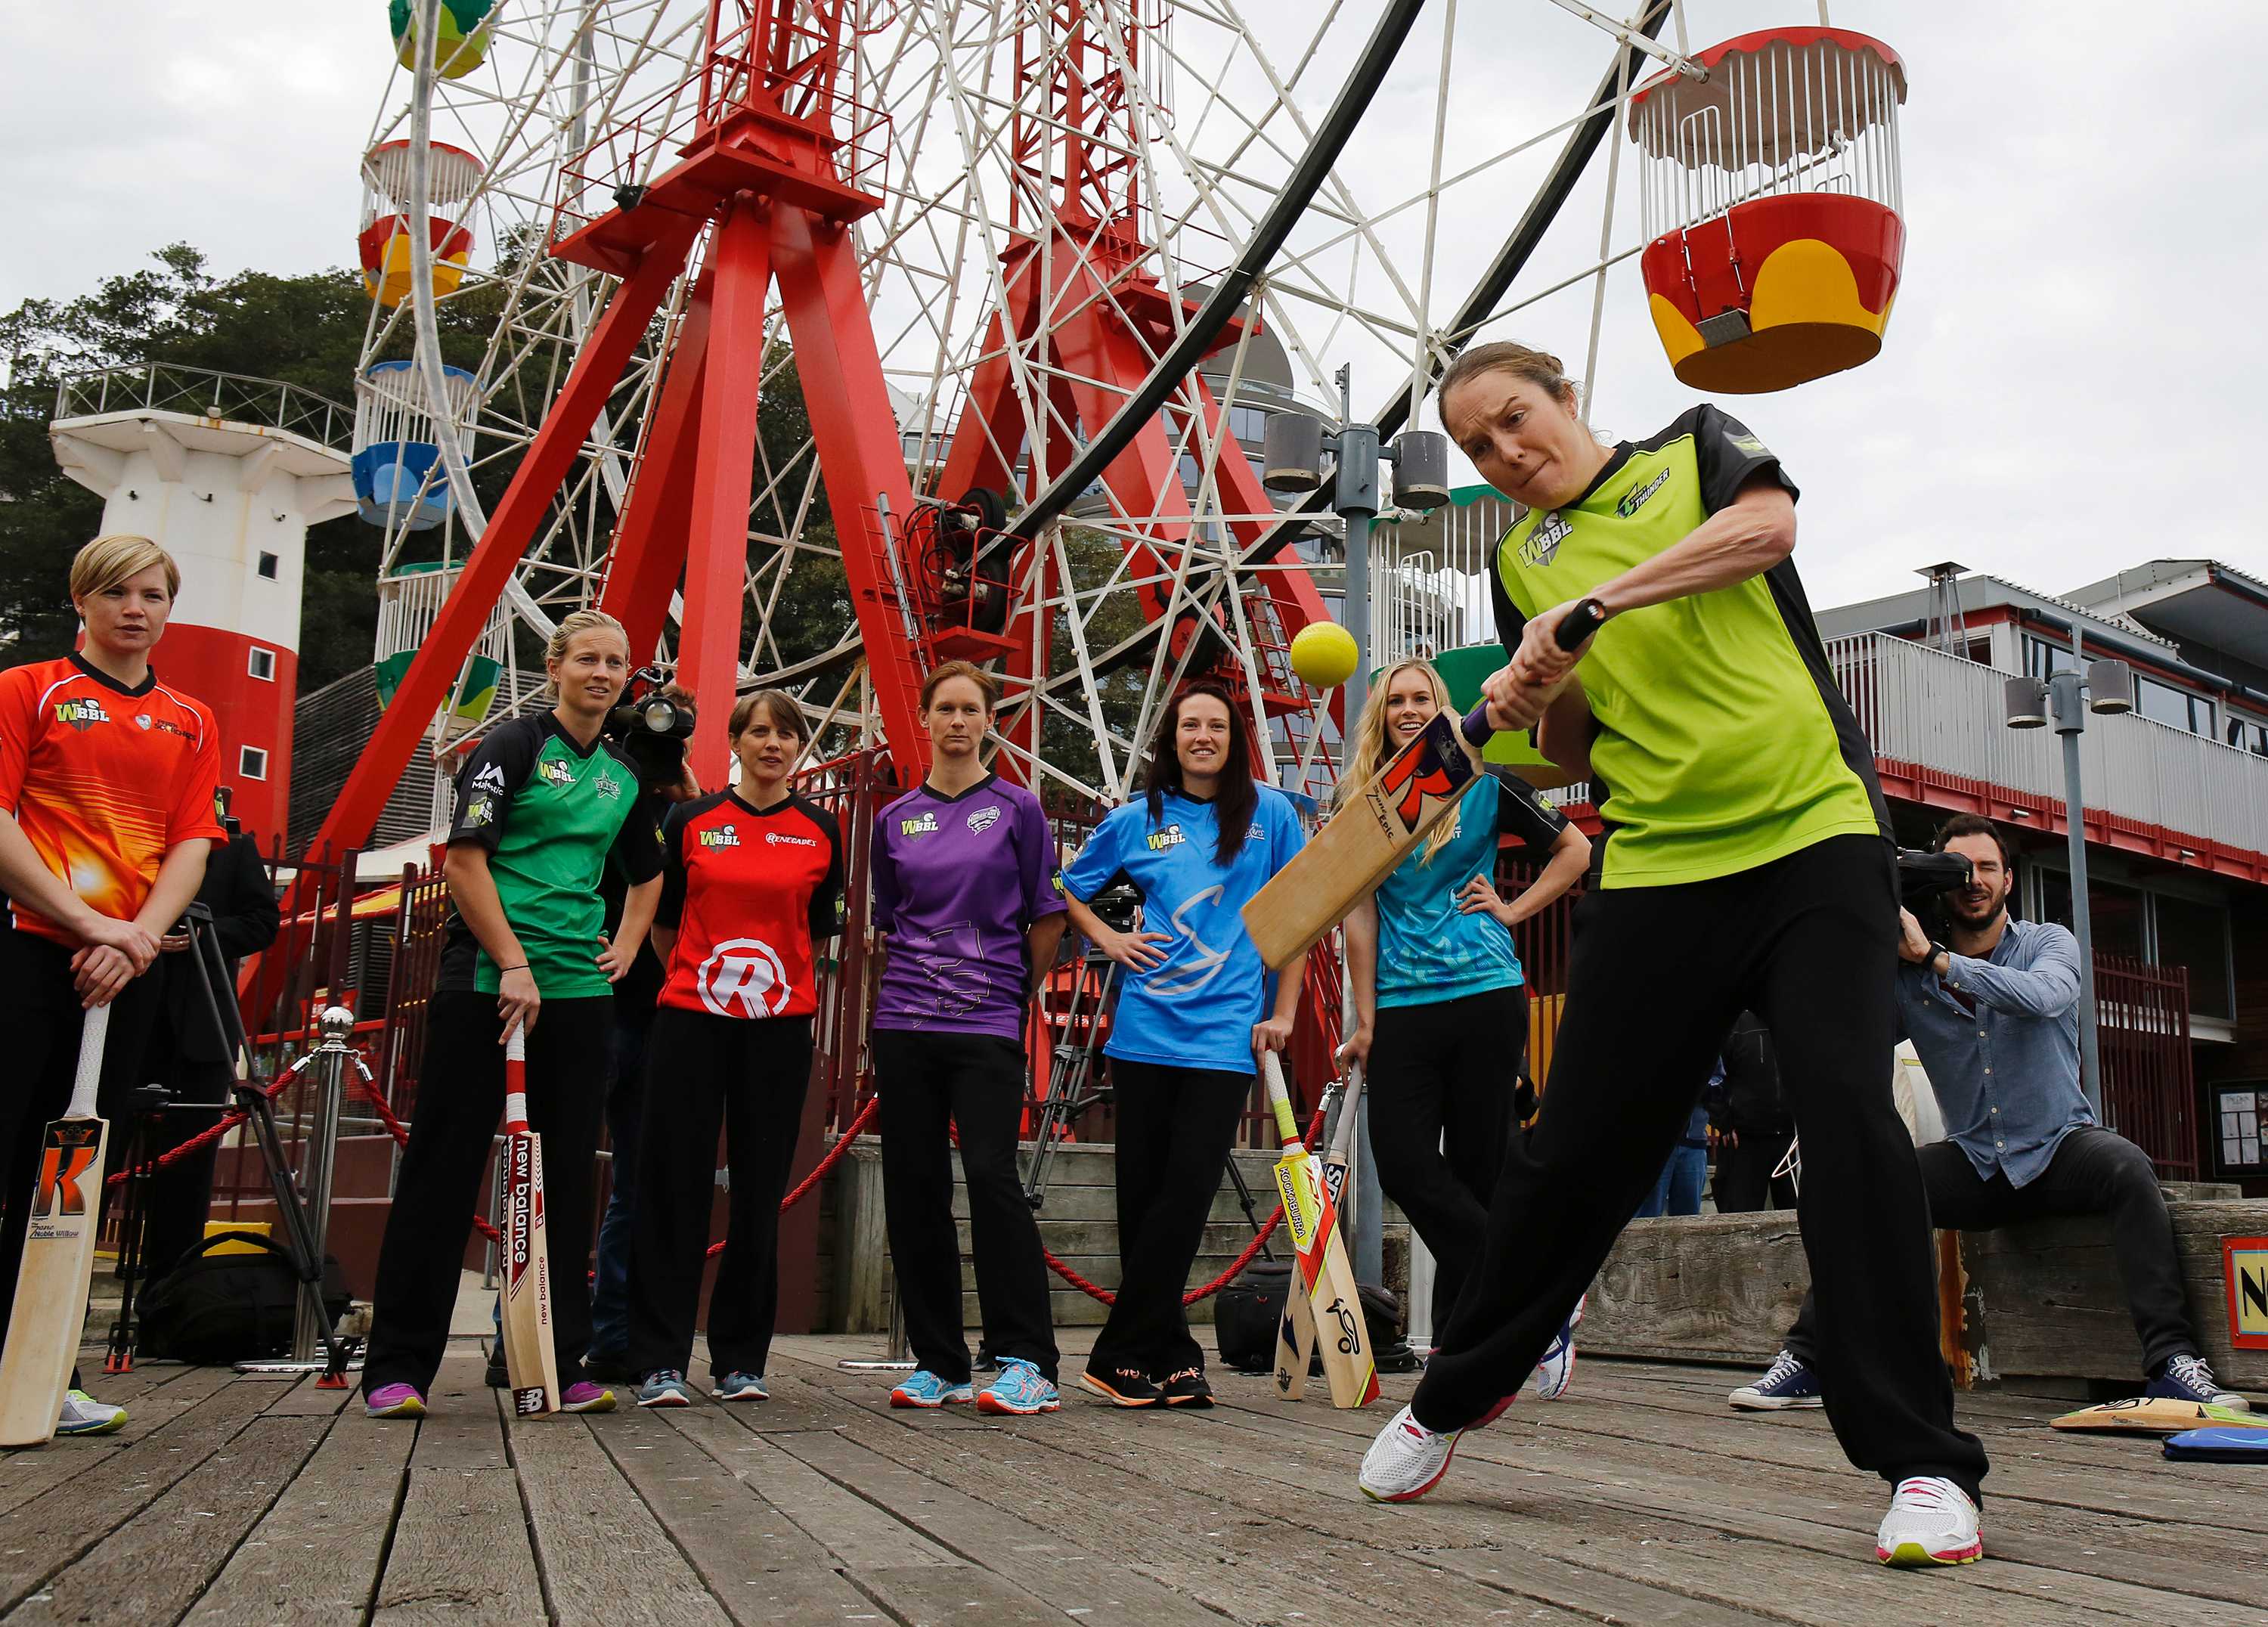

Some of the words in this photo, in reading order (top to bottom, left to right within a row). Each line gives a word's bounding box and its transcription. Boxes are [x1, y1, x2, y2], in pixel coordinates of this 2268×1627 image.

[1635, 469, 1668, 508] THUNDER
[1519, 519, 1573, 568] WBBL
[54, 704, 110, 723] WBBL
[539, 761, 577, 783] WBBL
[700, 831, 741, 846] WBBL
[766, 832, 817, 847] RENEGADES
[901, 819, 939, 835] WBBL
[1147, 833, 1185, 851] WBBL
[1379, 814, 1394, 838] Epic
[516, 1139, 528, 1178] new
[32, 1145, 97, 1216] K
[1279, 1167, 1306, 1239] KOOKABURRA
[514, 1183, 530, 1263] balance
[538, 1256, 547, 1300] balance
[2240, 1266, 2268, 1317] N
